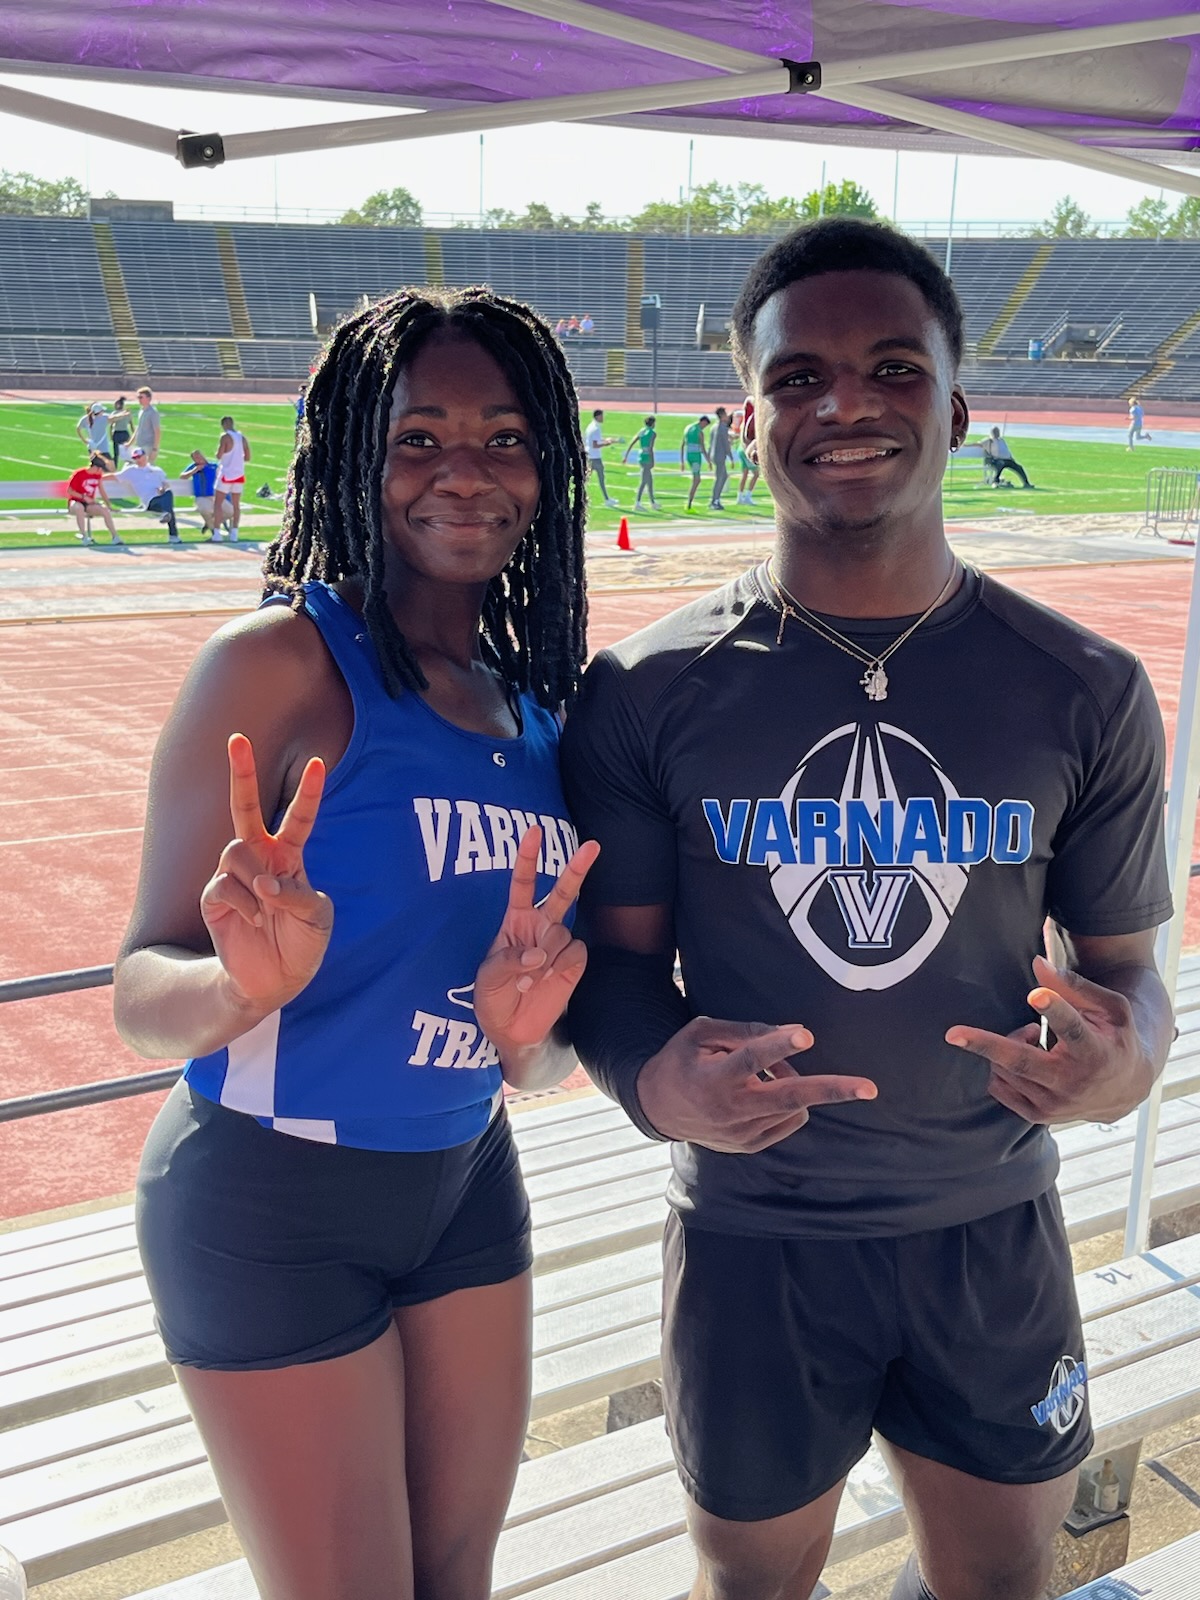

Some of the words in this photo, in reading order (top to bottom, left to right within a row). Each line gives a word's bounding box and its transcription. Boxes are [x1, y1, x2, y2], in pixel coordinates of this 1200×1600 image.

[701, 798, 1035, 866] VARNADO
[827, 870, 913, 948] V
[407, 1009, 500, 1069] TRA
[1094, 1267, 1133, 1285] 14
[1030, 1361, 1088, 1427] VARNAD
